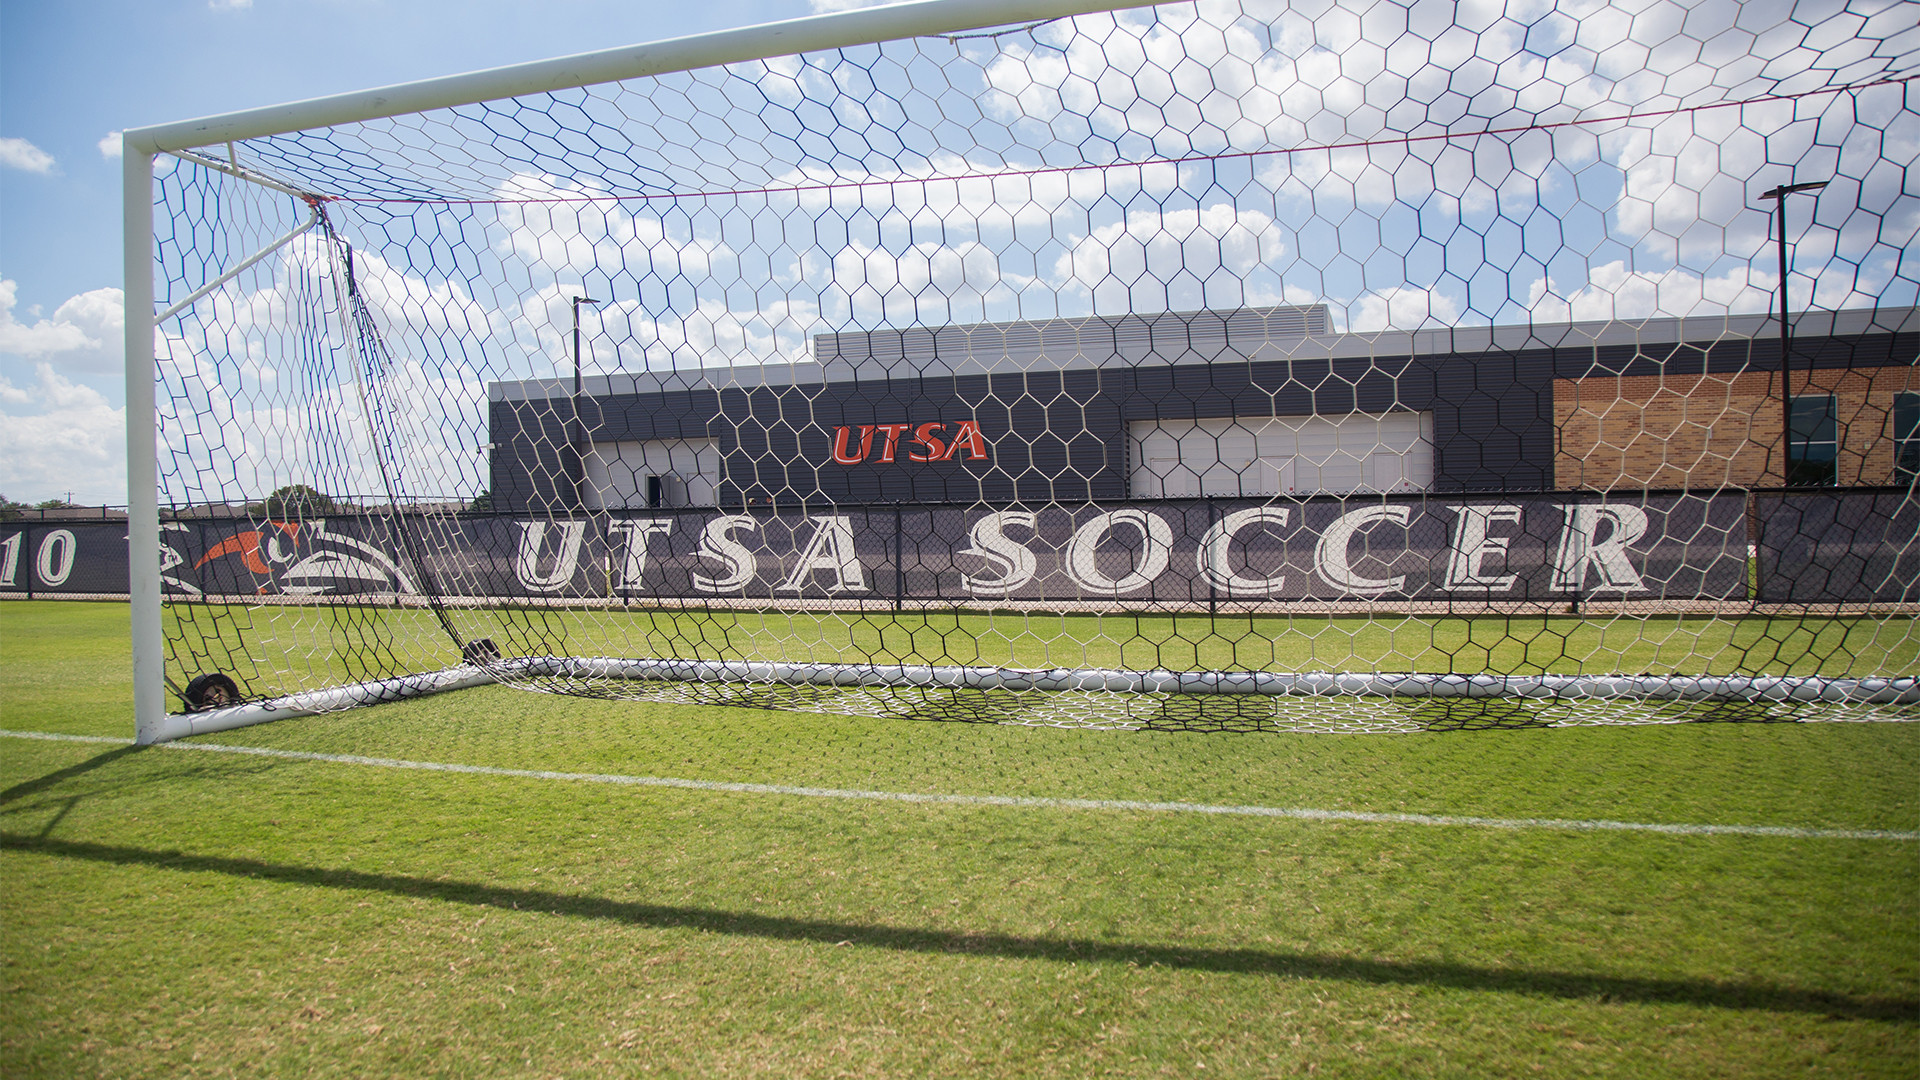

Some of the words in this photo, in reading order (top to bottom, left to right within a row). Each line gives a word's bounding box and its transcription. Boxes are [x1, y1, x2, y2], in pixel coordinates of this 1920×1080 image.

[832, 420, 988, 466] UTSA
[515, 514, 870, 593] UTSA
[957, 503, 1650, 596] SOCCER
